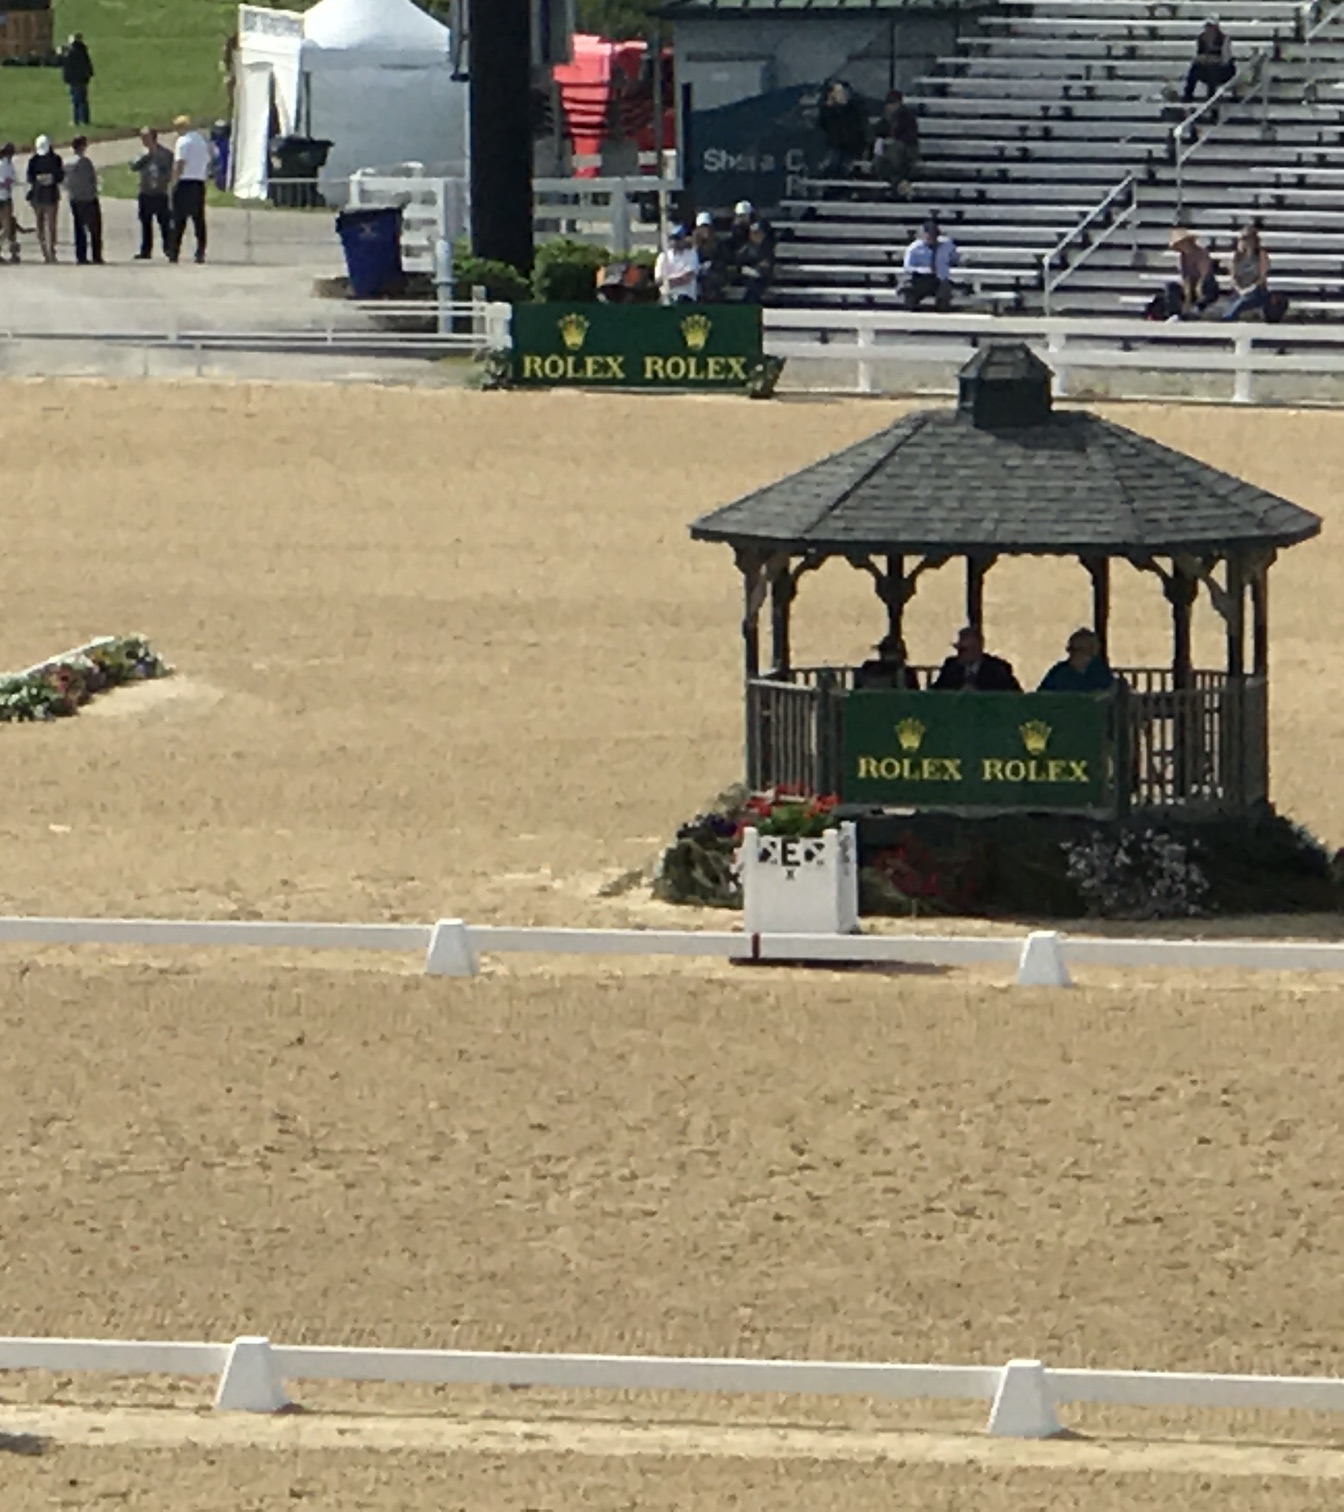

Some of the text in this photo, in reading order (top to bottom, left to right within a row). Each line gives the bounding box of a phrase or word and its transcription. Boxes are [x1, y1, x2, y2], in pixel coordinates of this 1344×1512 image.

[522, 354, 748, 381] ROLEX ROLEX
[857, 756, 1090, 783] ROLEX ROLEX
[781, 835, 801, 867] E
